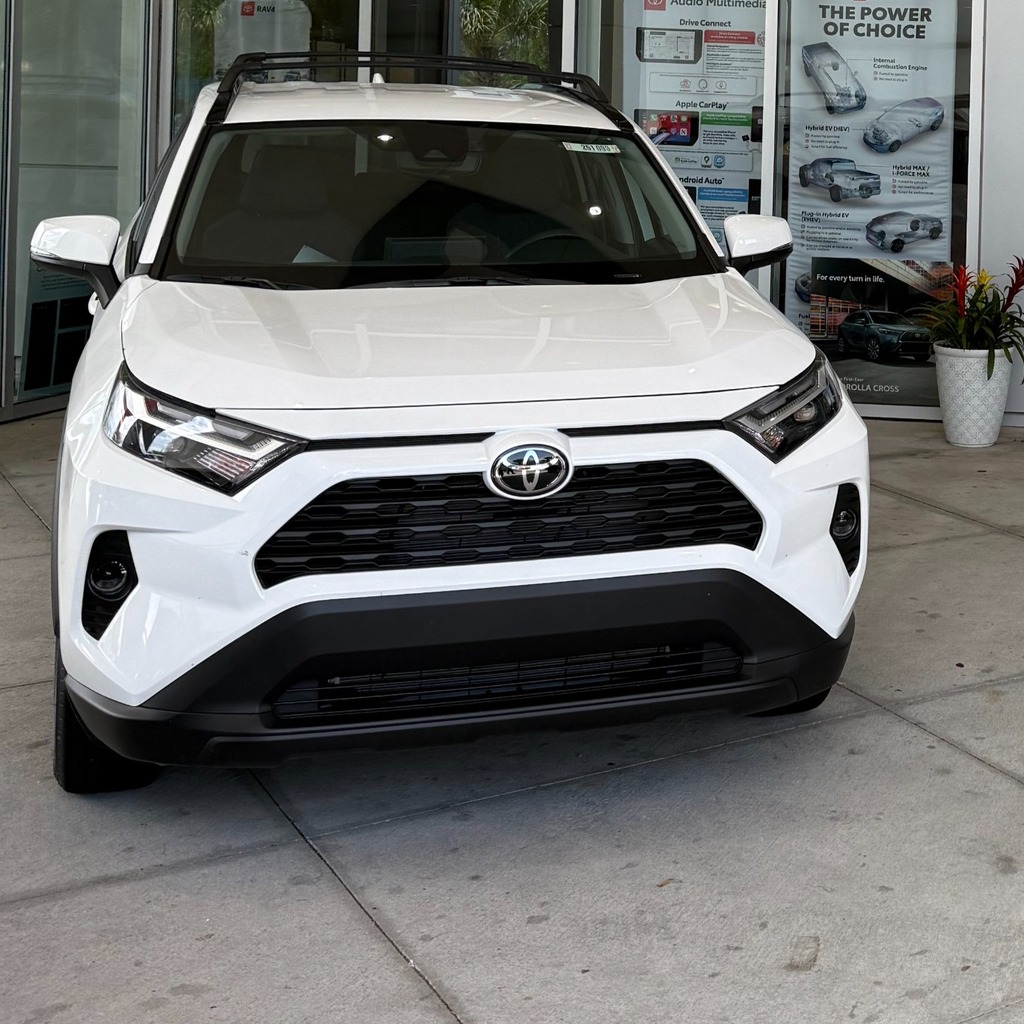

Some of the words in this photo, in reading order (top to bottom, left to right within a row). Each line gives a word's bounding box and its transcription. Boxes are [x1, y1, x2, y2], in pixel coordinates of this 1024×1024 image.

[819, 5, 855, 20] THE
[860, 7, 932, 22] POWER
[824, 22, 849, 36] OF
[854, 23, 925, 39] CHOICE
[676, 100, 697, 108] Apple
[679, 176, 703, 184] ndroid
